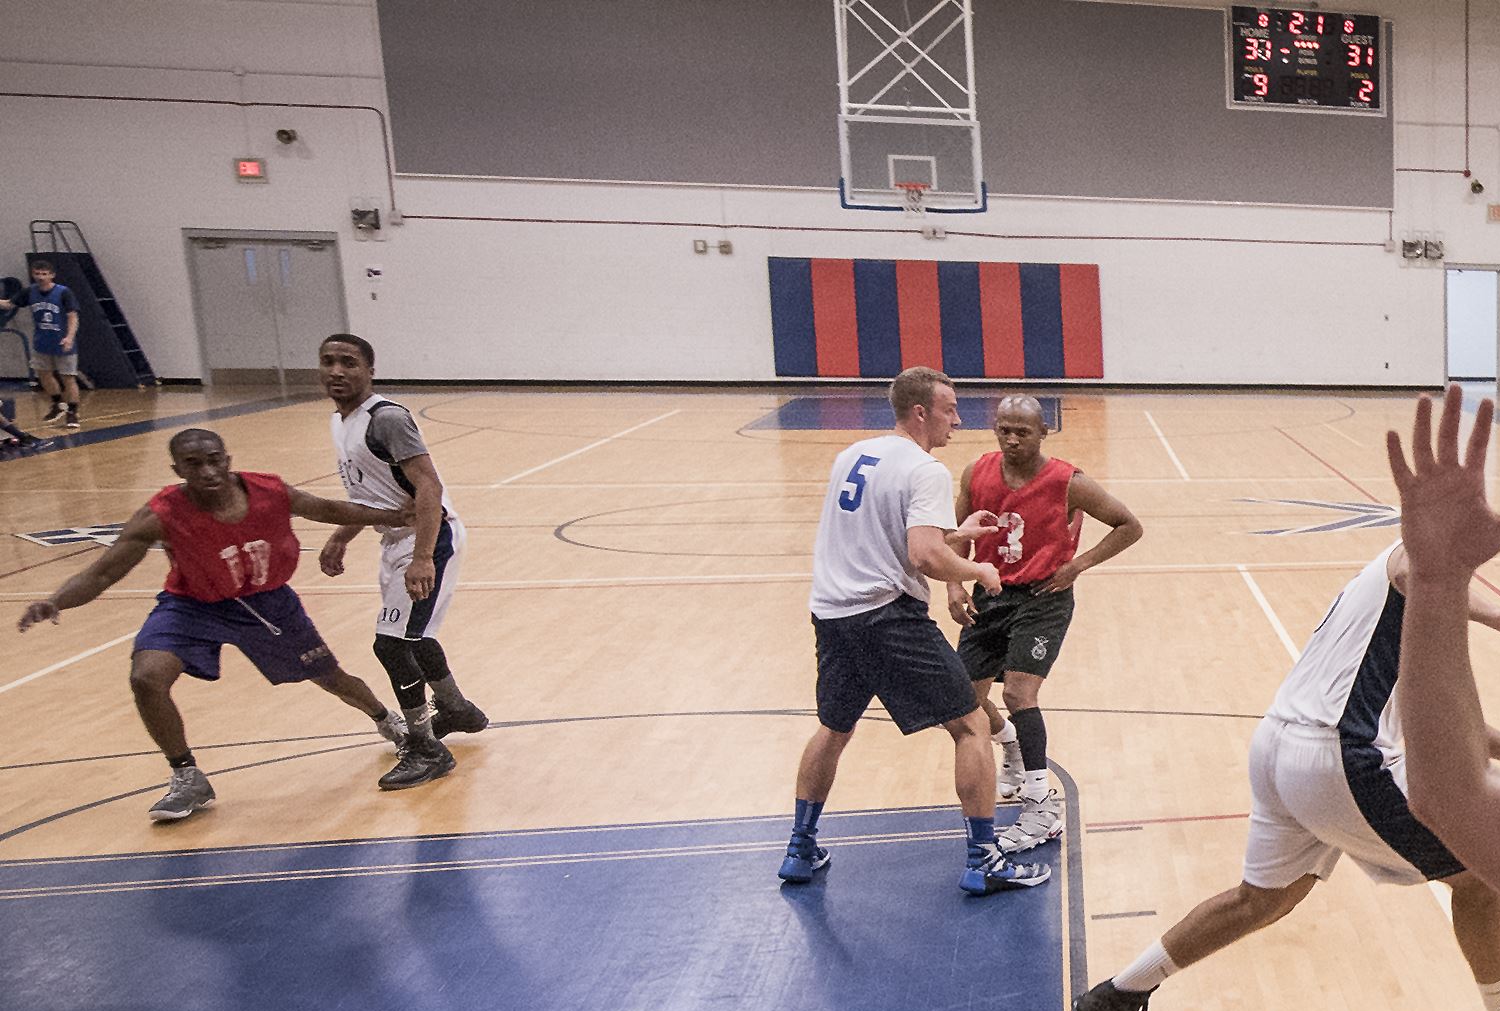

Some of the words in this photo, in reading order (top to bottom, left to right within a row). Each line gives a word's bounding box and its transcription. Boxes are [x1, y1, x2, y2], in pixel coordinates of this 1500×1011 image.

[1347, 44, 1374, 66] 31
[1253, 73, 1268, 97] 9
[1359, 79, 1374, 102] 2
[838, 454, 881, 513] 5
[998, 512, 1025, 564] 3
[381, 607, 401, 623] 10
